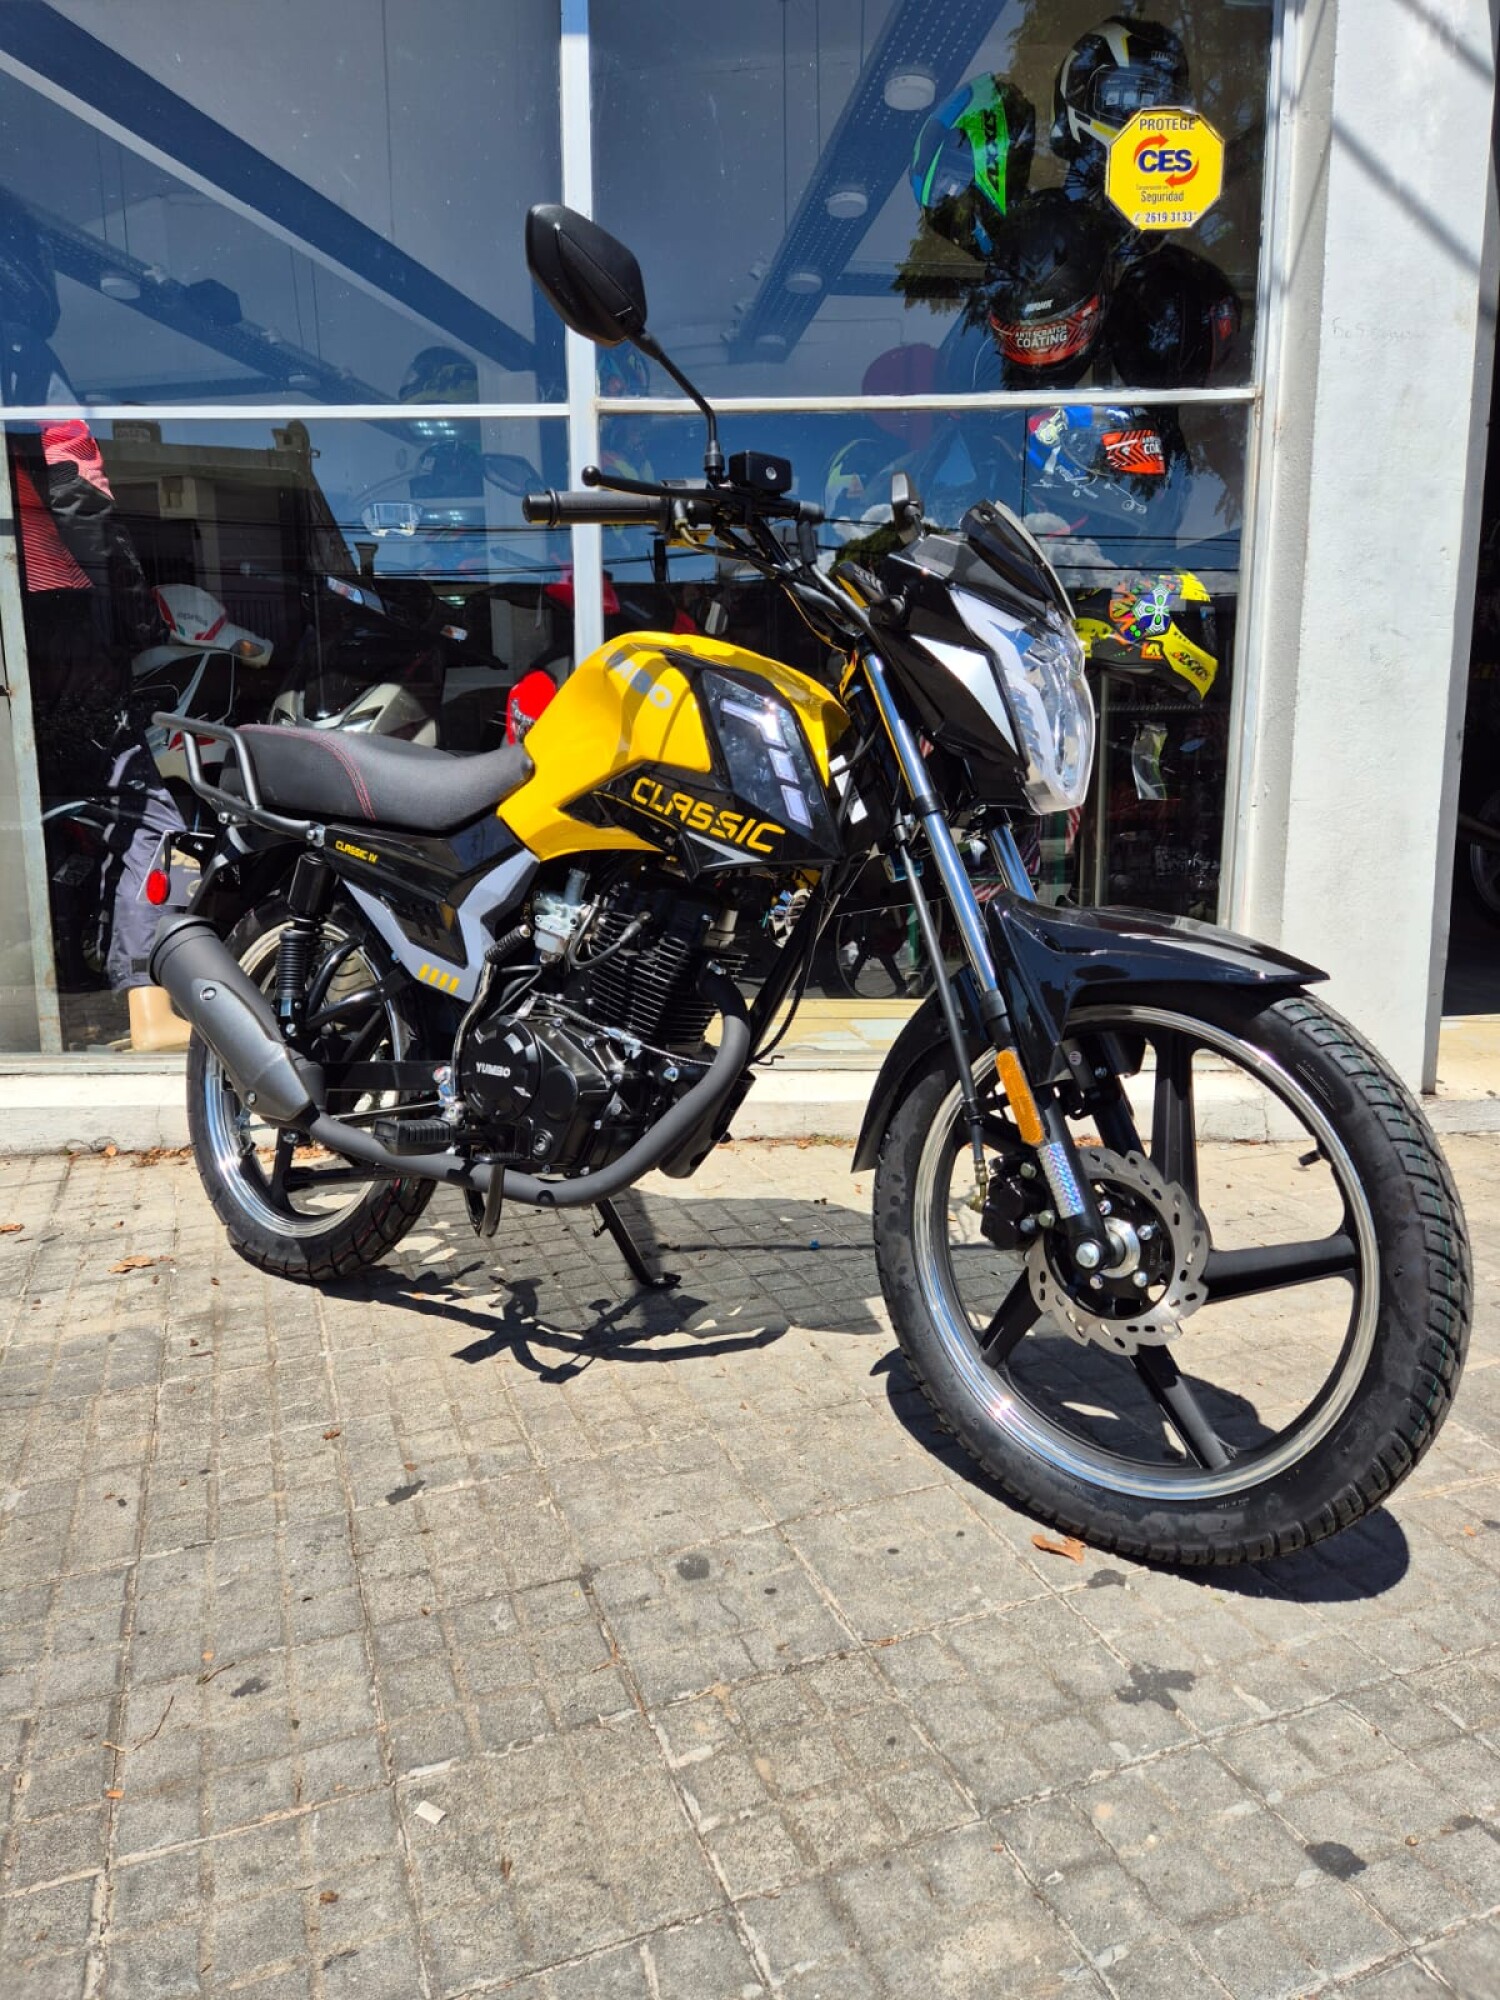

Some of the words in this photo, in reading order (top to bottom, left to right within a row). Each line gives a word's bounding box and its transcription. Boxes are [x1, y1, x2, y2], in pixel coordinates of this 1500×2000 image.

[1139, 118, 1196, 131] PROTEGE
[1138, 149, 1192, 173] CES
[1140, 190, 1185, 205] Seguridad
[1145, 211, 1168, 223] 2619
[1016, 332, 1067, 348] COATING
[631, 776, 786, 853] CLASSIC
[475, 1061, 511, 1079] YUMBO
